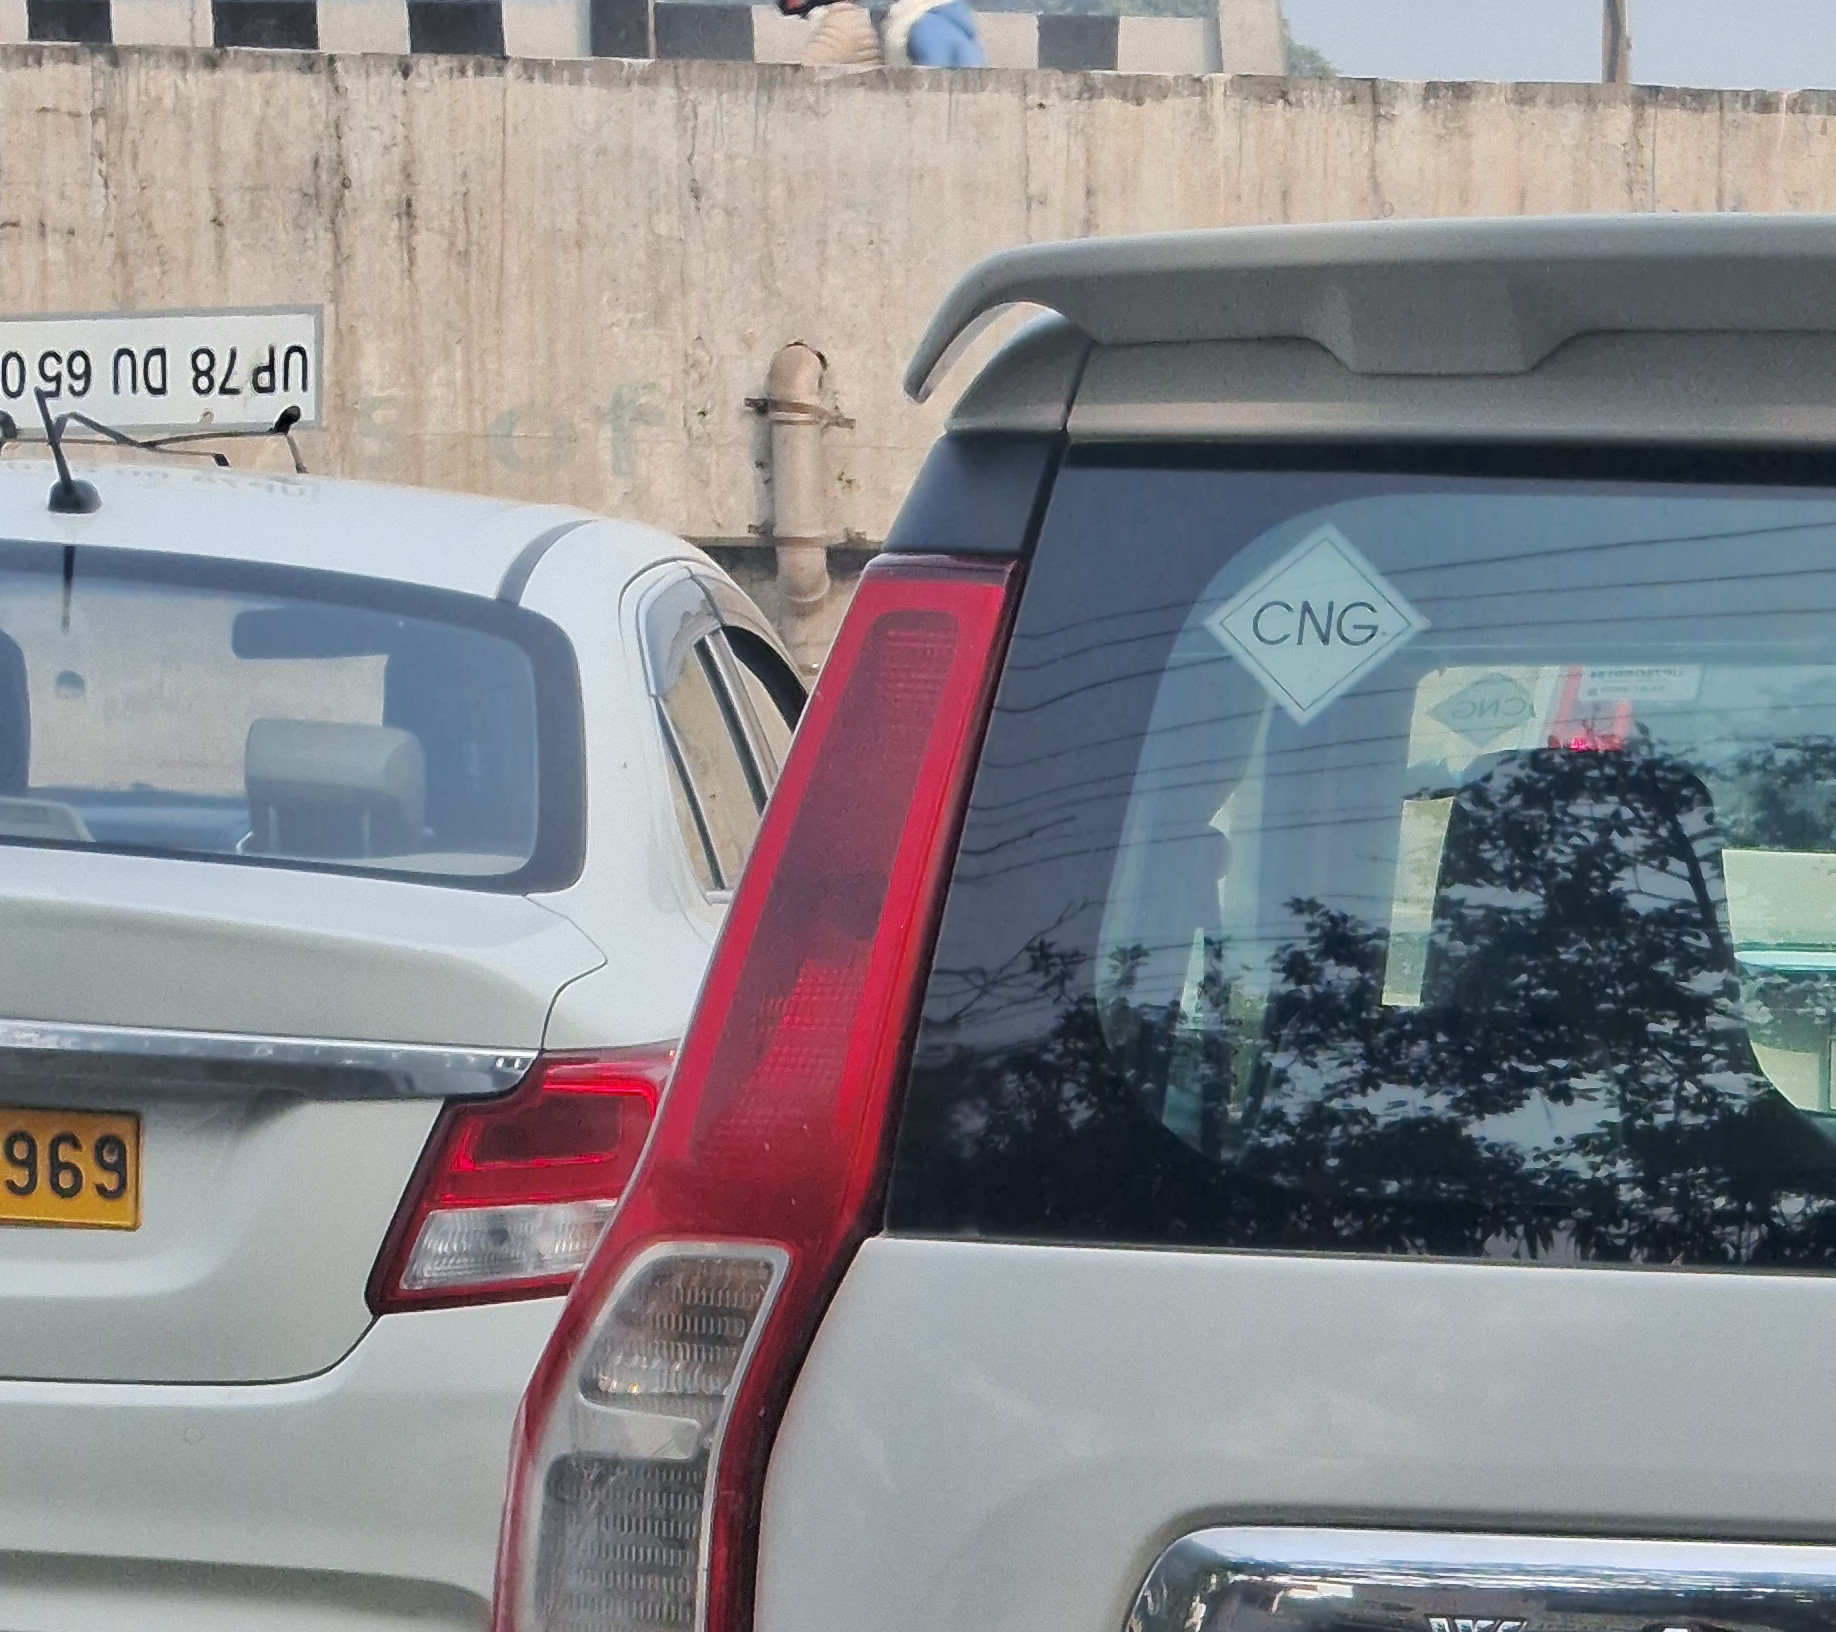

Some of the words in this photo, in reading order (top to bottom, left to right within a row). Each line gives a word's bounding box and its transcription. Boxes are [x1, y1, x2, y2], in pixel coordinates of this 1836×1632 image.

[112, 345, 168, 397] DU
[191, 344, 309, 396] UP78
[1252, 600, 1379, 647] CNG
[3, 1129, 128, 1200] 969
